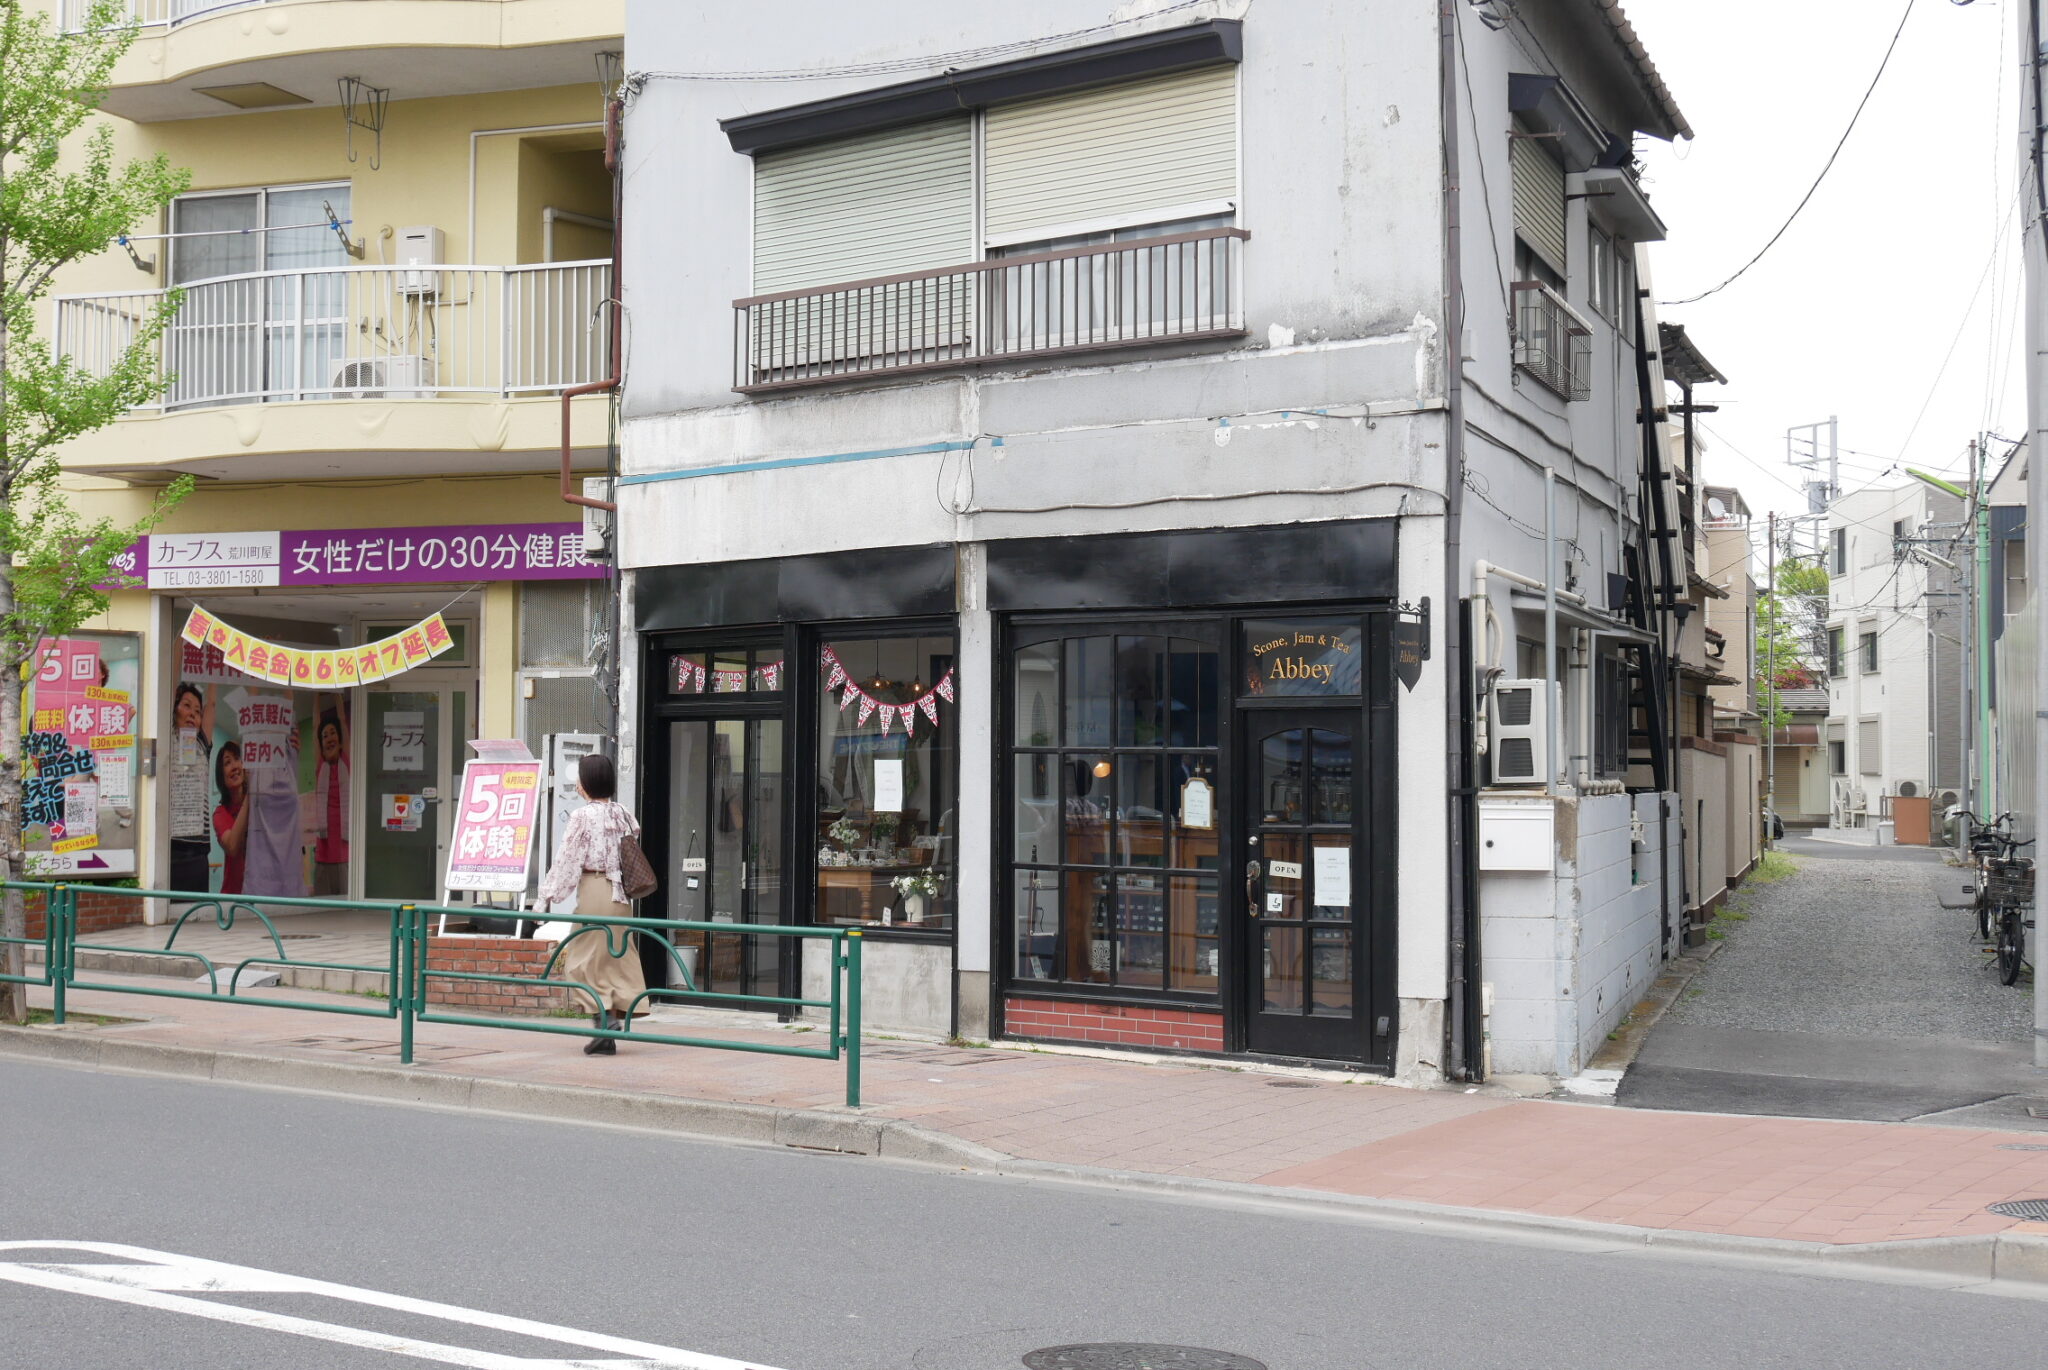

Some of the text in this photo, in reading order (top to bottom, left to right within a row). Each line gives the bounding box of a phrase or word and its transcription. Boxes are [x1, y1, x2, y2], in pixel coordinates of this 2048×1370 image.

[158, 540, 273, 563] カーブス 荒川町屋
[292, 533, 610, 575] 女性だけの30分健康
[164, 569, 264, 586] TEL. 03-3801-1580
[1253, 636, 1288, 657] Scone,
[1293, 631, 1315, 647] Jam
[1318, 634, 1327, 646] &
[40, 649, 96, 682] 5回
[1399, 649, 1419, 668] Abbey
[1269, 657, 1335, 685] Abbey
[239, 703, 293, 726] お気軽に
[380, 731, 428, 747] カーブス
[39, 749, 95, 778] 問合せ
[243, 741, 285, 763] 店内へ
[466, 774, 526, 823] 5回
[458, 824, 516, 860] 体験
[1274, 866, 1297, 874] OPEN
